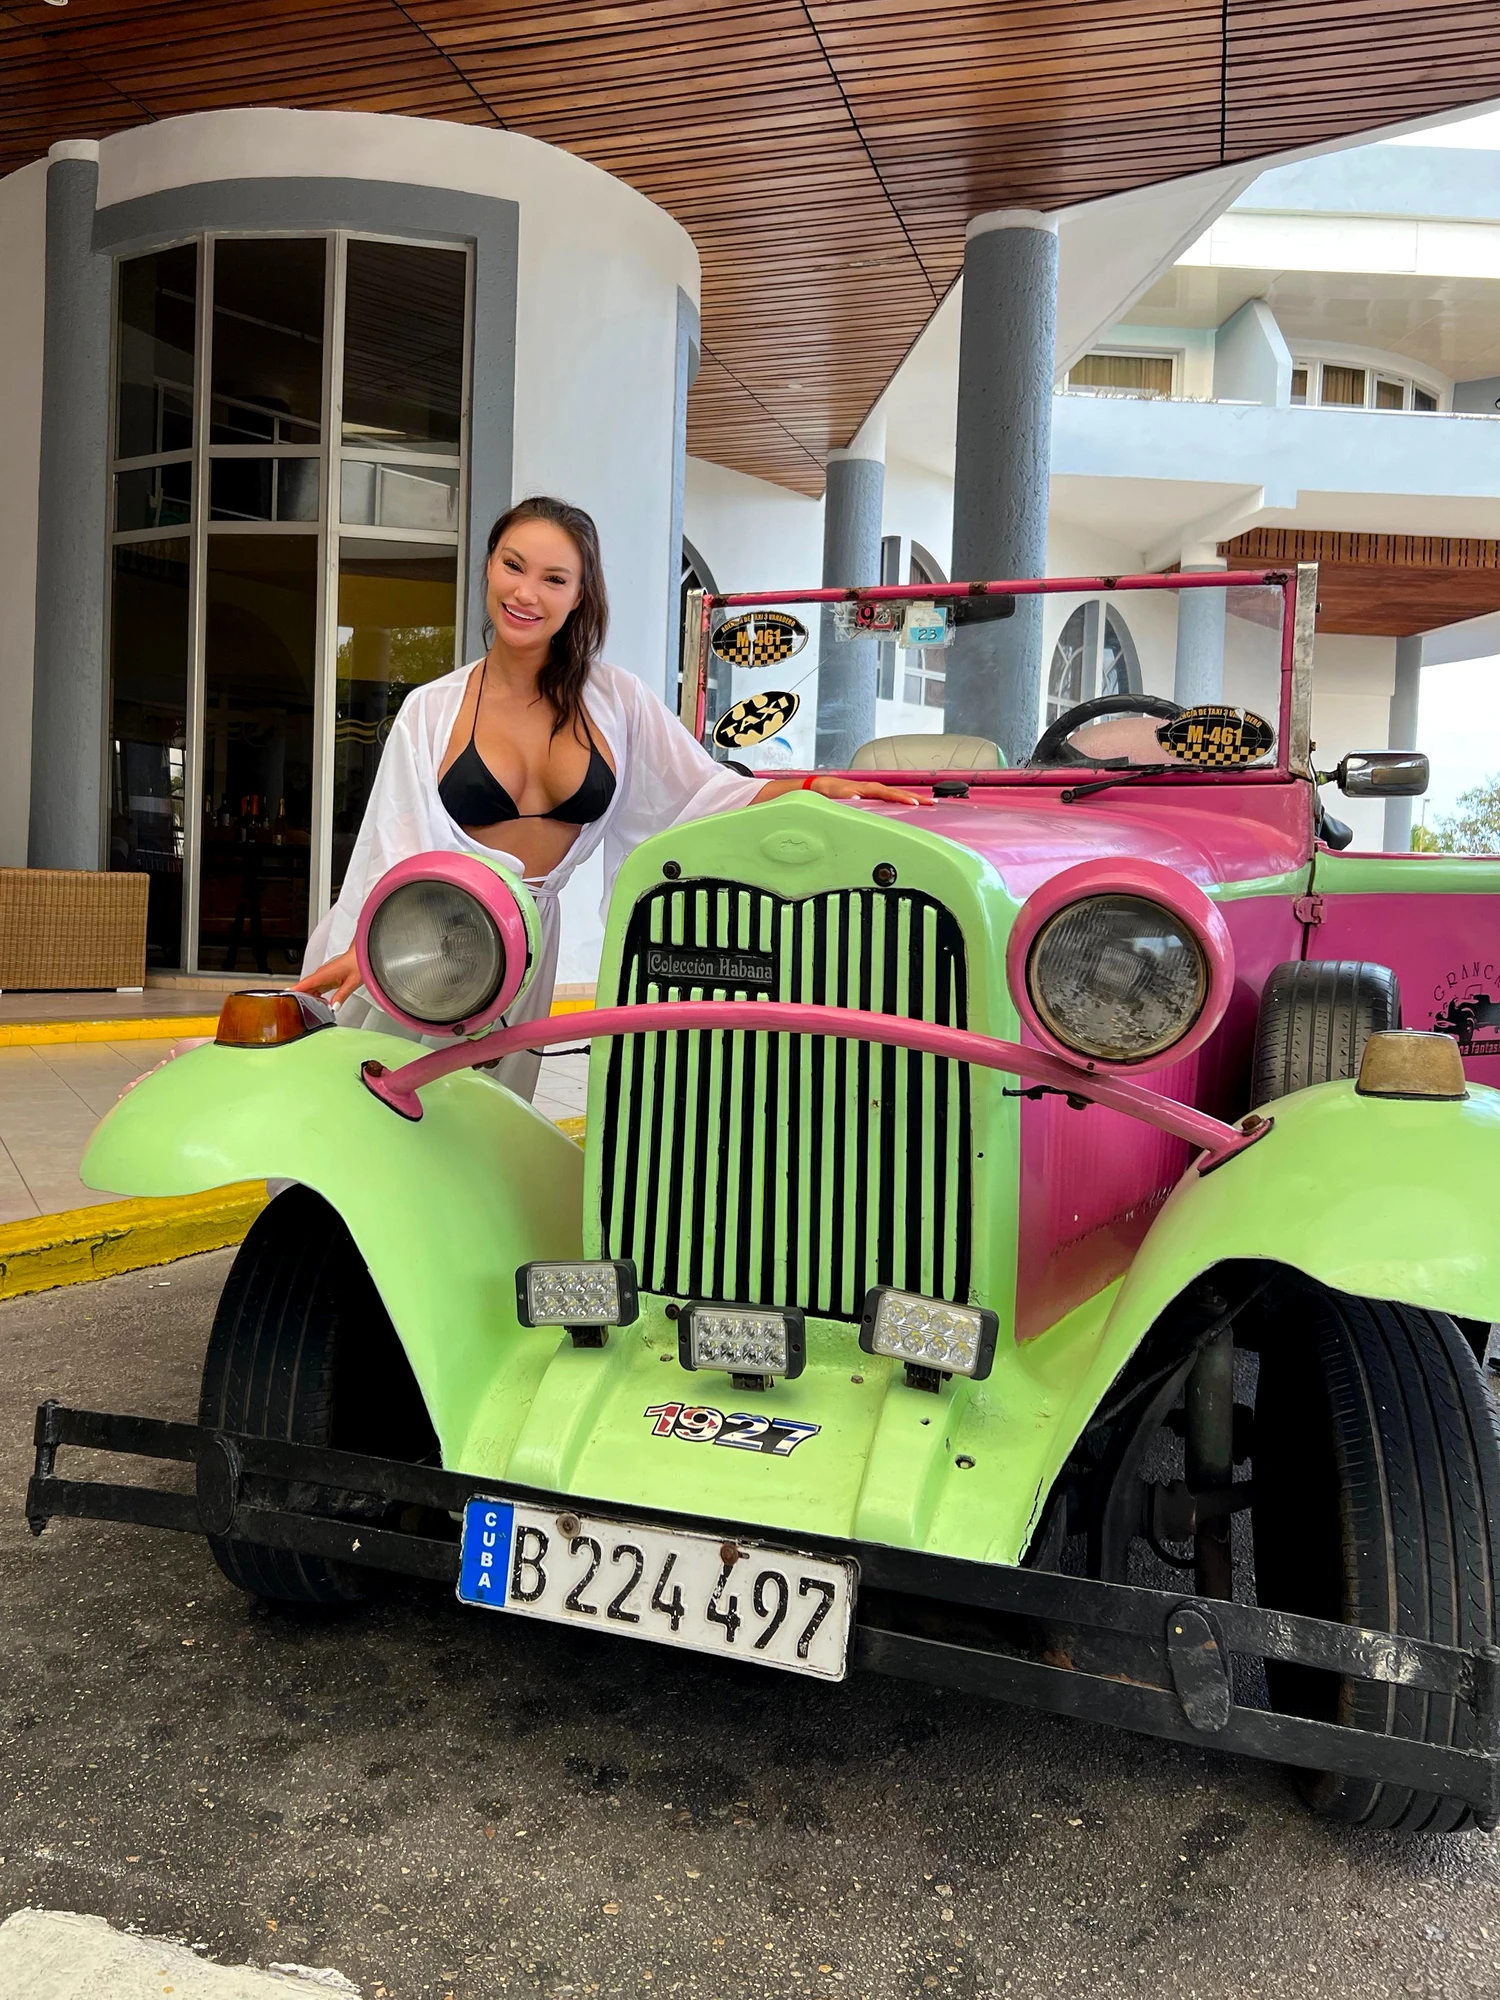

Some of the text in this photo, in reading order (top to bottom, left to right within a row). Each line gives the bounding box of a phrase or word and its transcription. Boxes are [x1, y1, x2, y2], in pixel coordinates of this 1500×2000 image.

[764, 613, 768, 621] 3
[769, 614, 796, 627] VARADERO
[918, 628, 938, 640] 23
[720, 696, 789, 738] TAXI
[1199, 708, 1207, 716] DE
[1208, 708, 1223, 716] TAXI
[1229, 709, 1263, 728] VADERO
[1187, 725, 1242, 746] M-461
[650, 953, 773, 979] Colección Habana
[644, 1401, 822, 1457] 1927
[477, 1512, 498, 1588] CUBA
[511, 1525, 835, 1658] B 224 497
